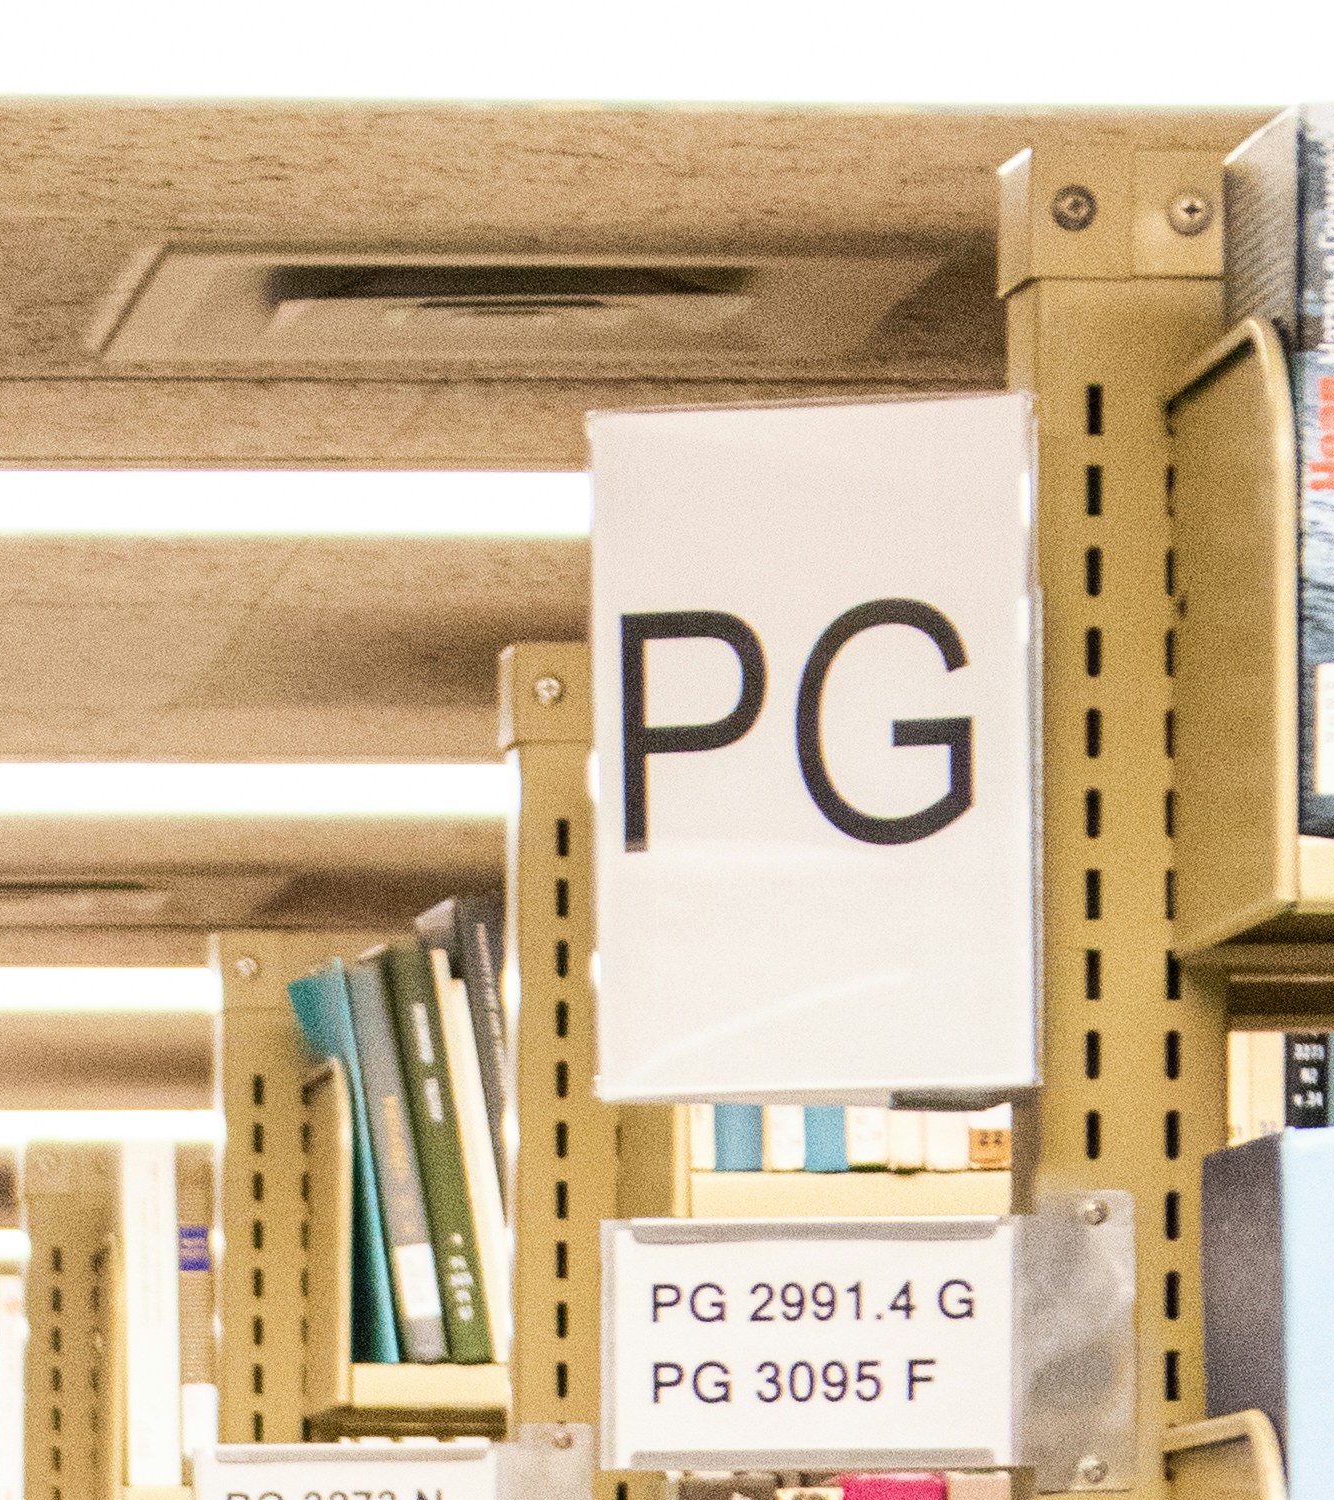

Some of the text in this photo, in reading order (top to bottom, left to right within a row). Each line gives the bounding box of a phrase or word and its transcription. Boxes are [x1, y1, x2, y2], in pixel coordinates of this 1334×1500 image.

[621, 598, 973, 852] PG
[651, 1278, 975, 1324] PG 2991.4 G
[651, 1357, 936, 1405] PG 3095 F
